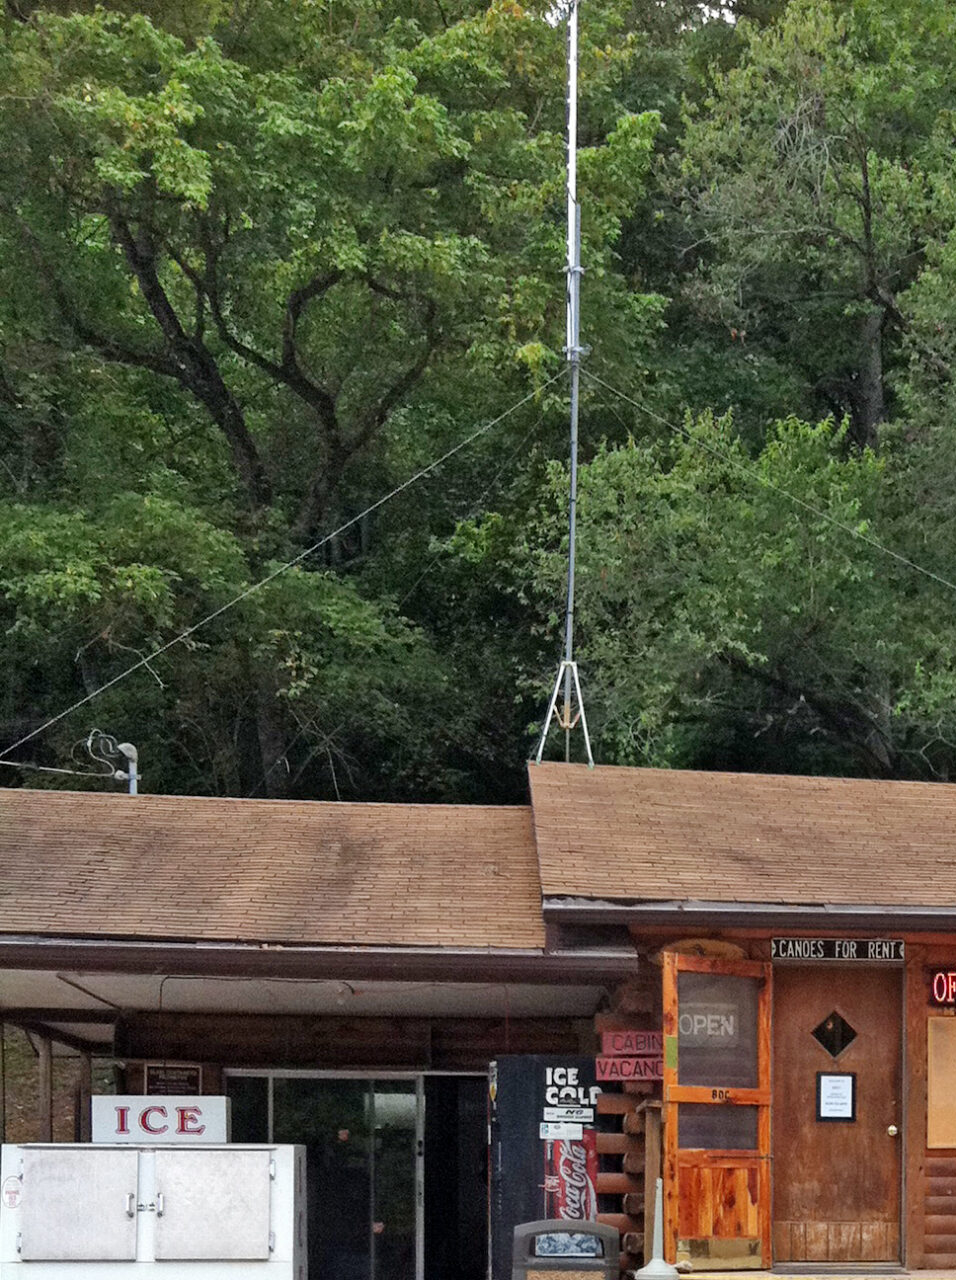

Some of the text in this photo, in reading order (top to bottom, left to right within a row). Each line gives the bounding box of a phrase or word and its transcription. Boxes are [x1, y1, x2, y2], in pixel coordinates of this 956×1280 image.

[779, 940, 896, 959] CANOES FOR RENT
[679, 1014, 735, 1035] OPEN
[546, 1067, 579, 1086] ICE
[598, 1061, 664, 1077] VACANC
[115, 1106, 206, 1135] ICE
